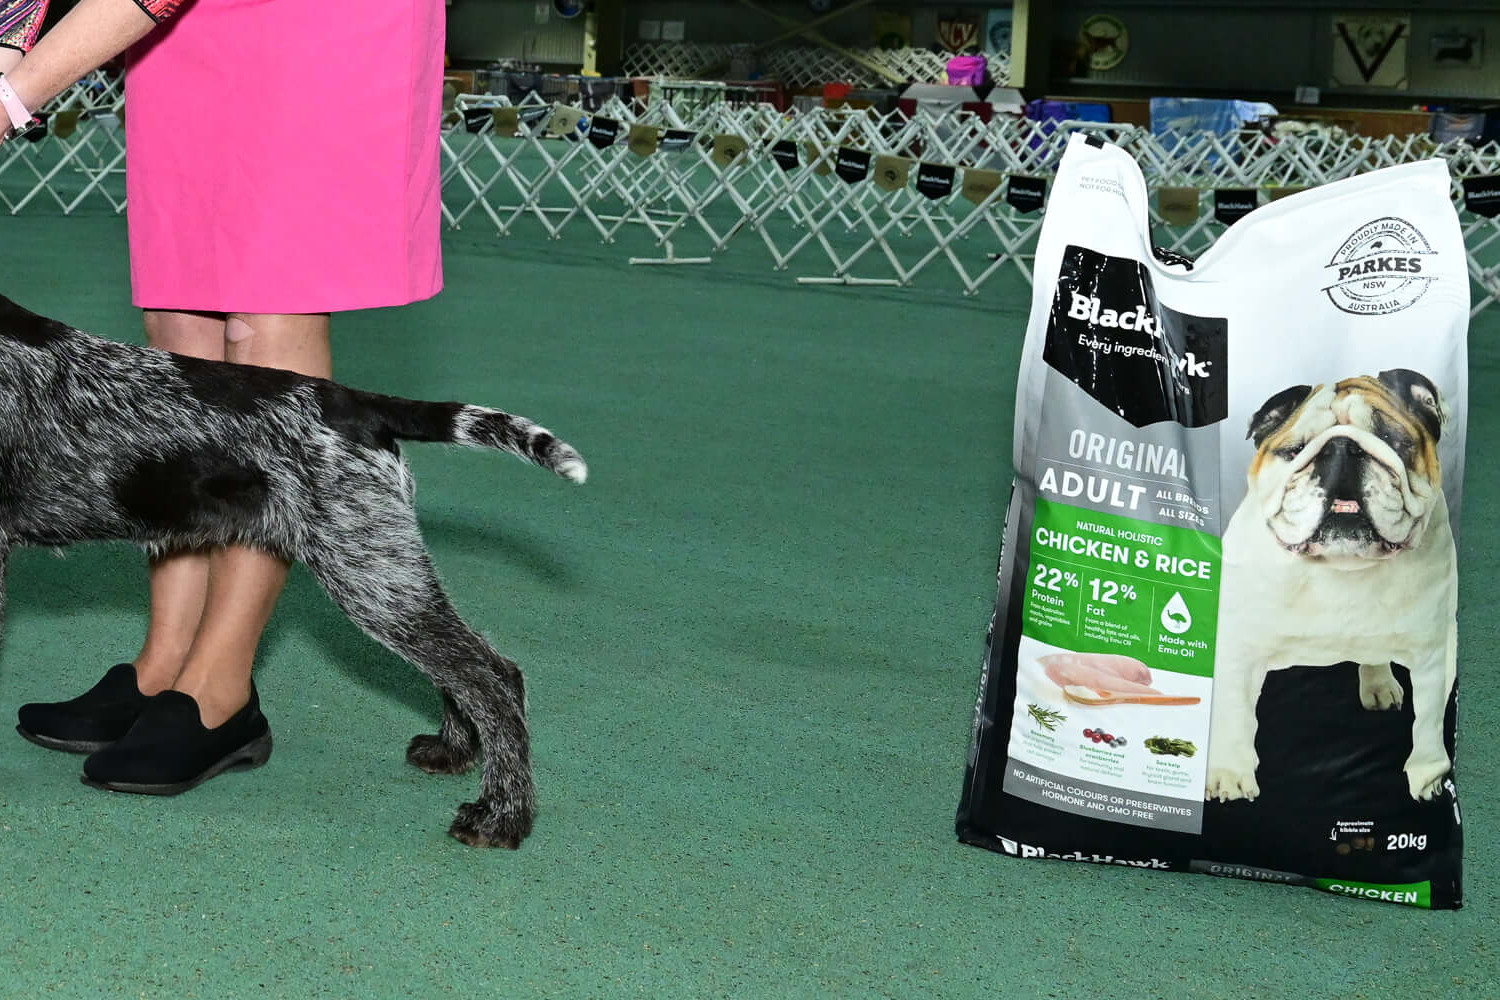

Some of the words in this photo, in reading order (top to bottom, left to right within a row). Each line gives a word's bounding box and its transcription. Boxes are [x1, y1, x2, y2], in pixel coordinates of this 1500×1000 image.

[1340, 225, 1379, 256] PROUDLY
[1381, 222, 1407, 235] MADE
[1407, 233, 1419, 245] IN
[1338, 257, 1422, 281] PARKES
[1363, 280, 1387, 289] NSW
[1348, 299, 1400, 312] AUSTRALIA
[1078, 333, 1112, 354] Every
[1114, 342, 1169, 366] ingredien
[1069, 429, 1189, 482] ORIGINAL
[1039, 467, 1147, 511] ADULT
[1156, 490, 1172, 501] ALL
[1159, 507, 1175, 518] ALL
[1076, 520, 1116, 537] NATURAL
[1117, 529, 1164, 546] HOLISTIC
[1036, 527, 1130, 565] CHICKEN
[1134, 550, 1150, 568] &
[1155, 553, 1212, 580] RICE
[1033, 563, 1079, 592] 22%
[1031, 589, 1065, 607] Protein
[1089, 578, 1137, 605] 12%
[1086, 604, 1105, 617] Fat
[1158, 644, 1179, 656] Emu
[1180, 648, 1195, 659] Oil
[1159, 634, 1186, 646] Made
[1187, 638, 1208, 650] with
[1013, 768, 1025, 779] NO
[1025, 773, 1065, 792] ARTIFICIAL
[1066, 786, 1109, 802] COLOURS
[1110, 796, 1124, 804] OR
[1126, 799, 1192, 816] PRESERVATIVES
[1042, 789, 1085, 807] HORMONE
[1086, 801, 1105, 811] AND
[1107, 805, 1130, 816] GMO
[1132, 810, 1154, 820] FREE
[1387, 833, 1427, 850] 20kg
[1328, 884, 1418, 903] CHICKEN
